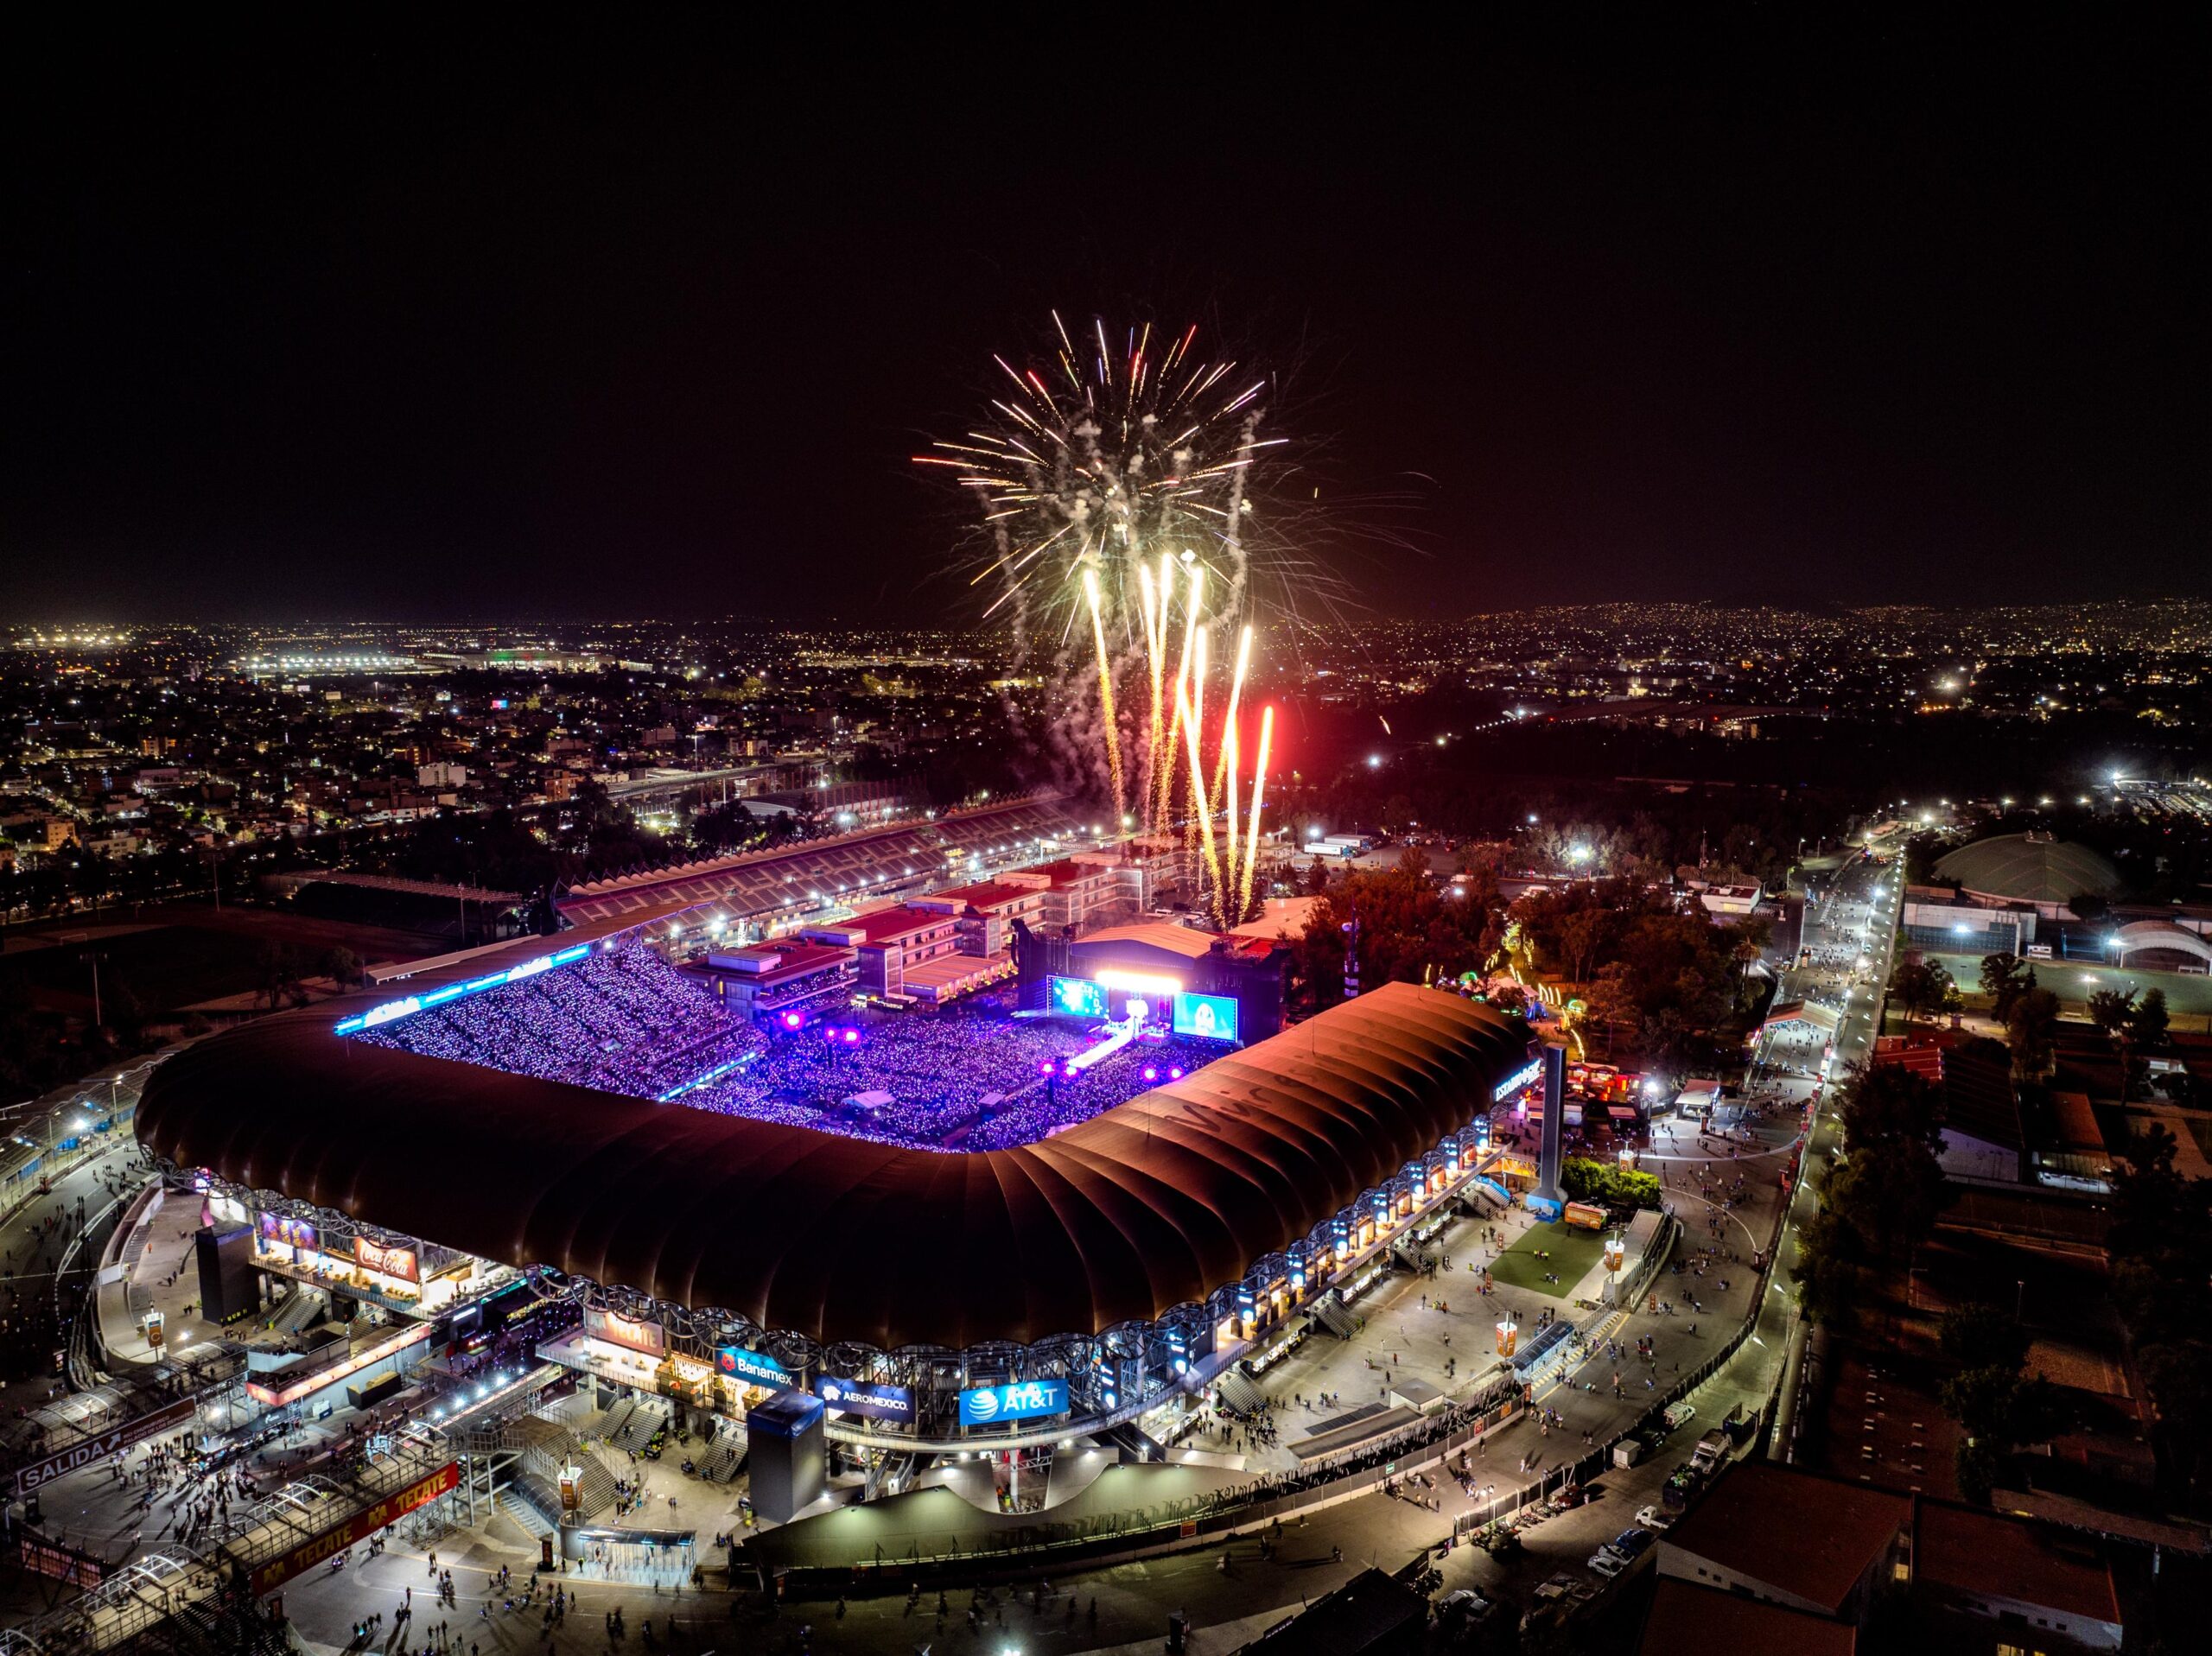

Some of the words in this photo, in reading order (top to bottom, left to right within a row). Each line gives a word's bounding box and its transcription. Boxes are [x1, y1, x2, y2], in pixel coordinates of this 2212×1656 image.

[1507, 1342, 1515, 1352] F
[737, 1357, 792, 1386] Banamex
[1003, 1387, 1058, 1412] AT&T
[25, 1442, 105, 1488] SALIDA
[395, 1470, 448, 1513] TECATE
[293, 1522, 353, 1569] TECATE
